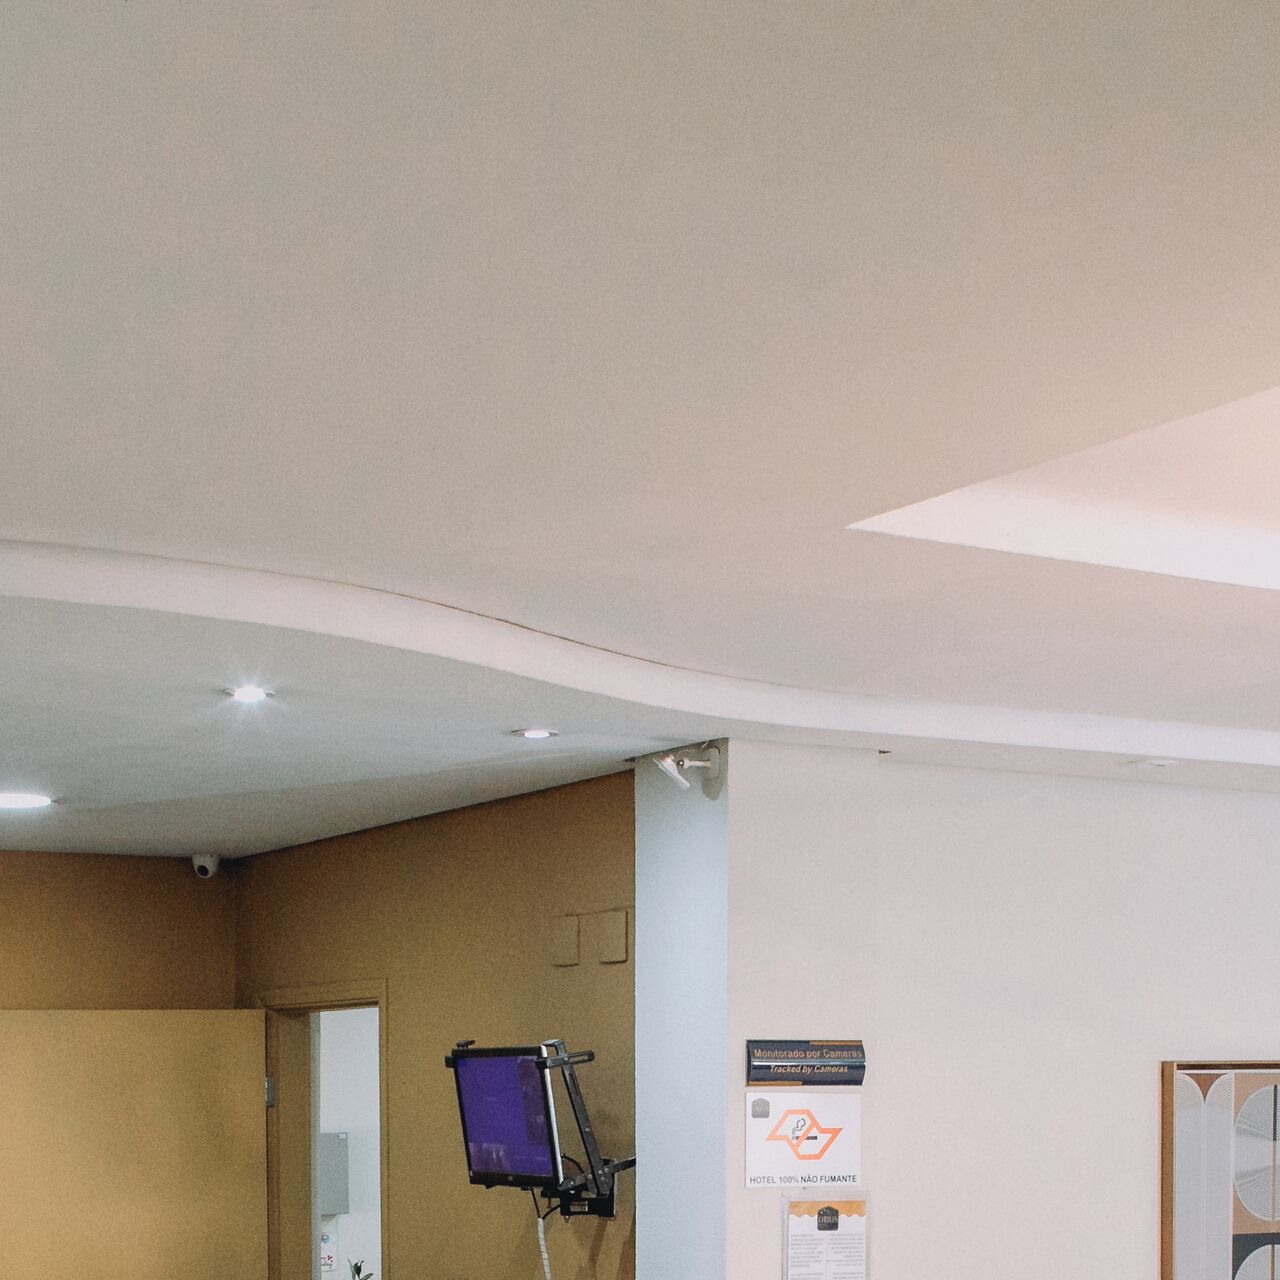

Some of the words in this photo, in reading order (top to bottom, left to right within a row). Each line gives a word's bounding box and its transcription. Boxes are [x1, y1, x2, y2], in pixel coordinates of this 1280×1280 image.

[753, 1049, 805, 1058] Monitorado
[806, 1050, 821, 1060] por
[770, 1065, 801, 1073] Tracked
[802, 1065, 813, 1074] by
[814, 1065, 848, 1073] Cameras
[749, 1176, 777, 1184] HOTEL
[779, 1176, 800, 1184] 100%
[800, 1174, 818, 1183] NÃO
[819, 1175, 857, 1183] FUMANTE
